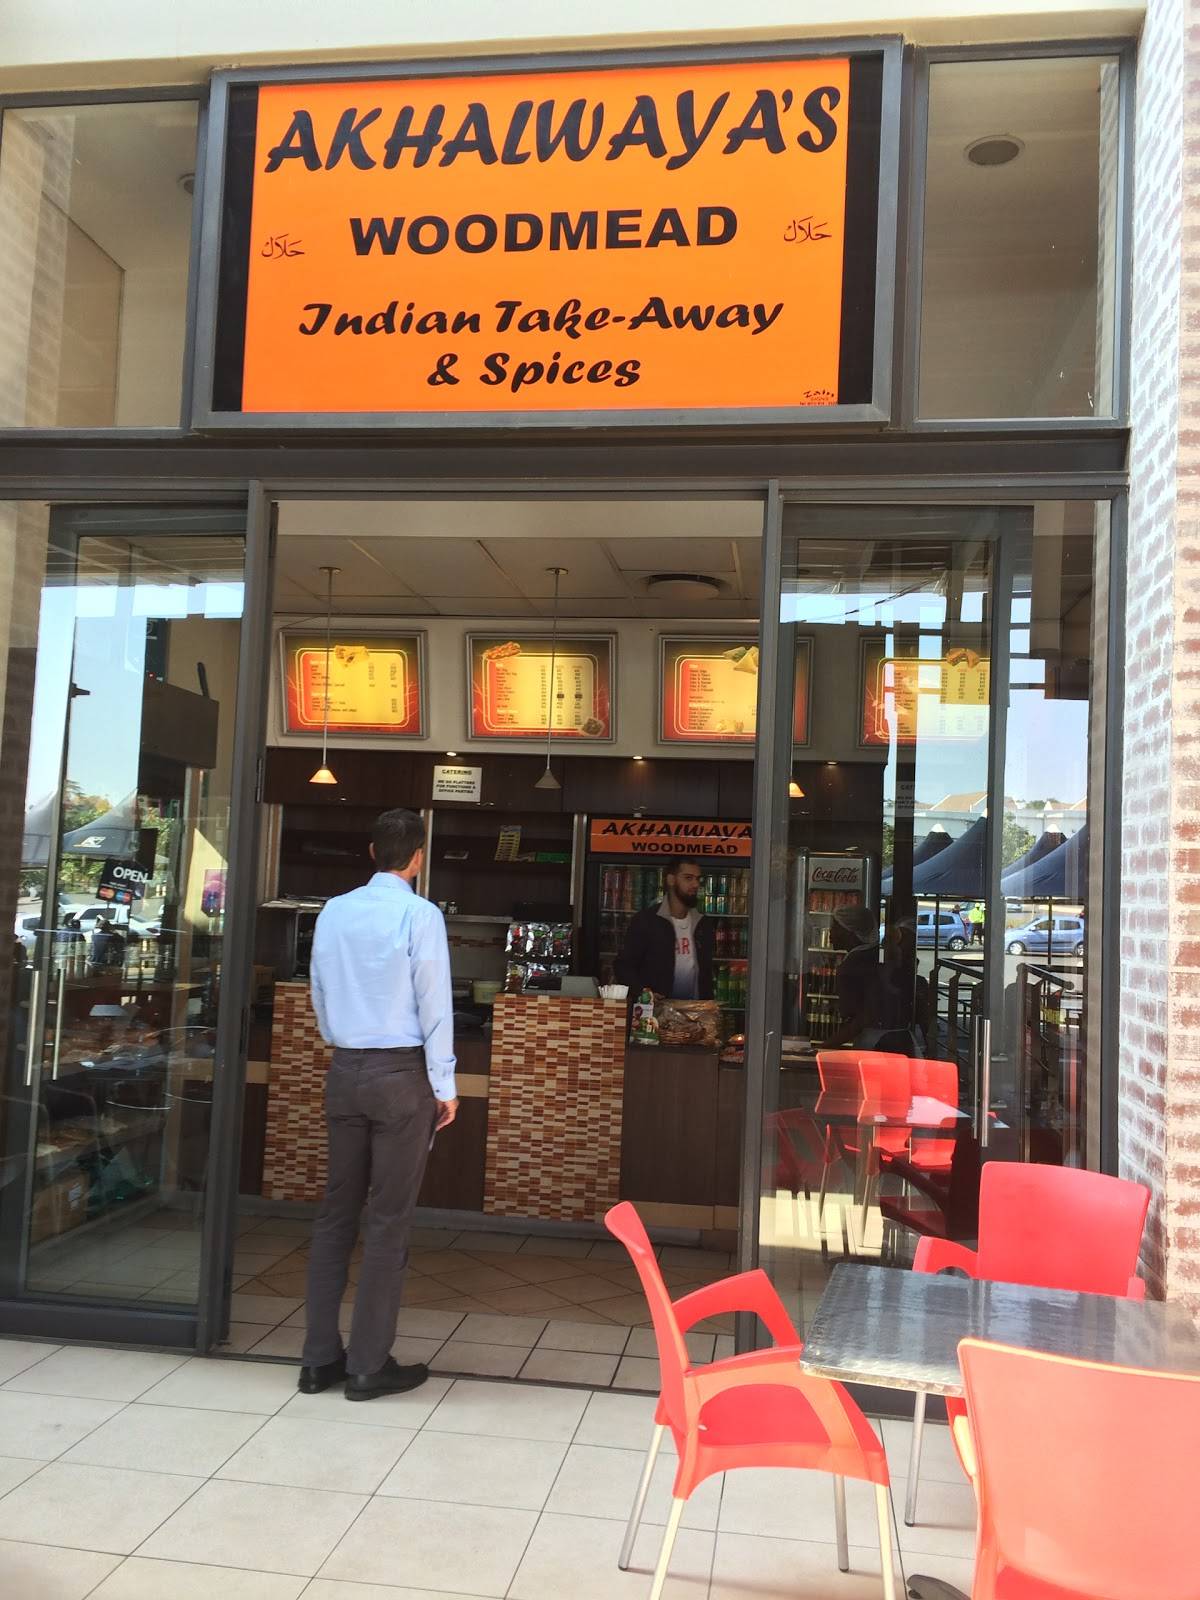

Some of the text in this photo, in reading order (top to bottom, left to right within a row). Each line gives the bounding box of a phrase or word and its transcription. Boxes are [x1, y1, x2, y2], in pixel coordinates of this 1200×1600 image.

[264, 86, 841, 173] AKHALWAYA'S
[350, 206, 738, 256] WOODMEAD
[298, 296, 784, 340] Indian Take-Away
[427, 351, 641, 393] & Spices
[631, 841, 739, 855] WOODMEAD
[113, 866, 149, 883] OPEN
